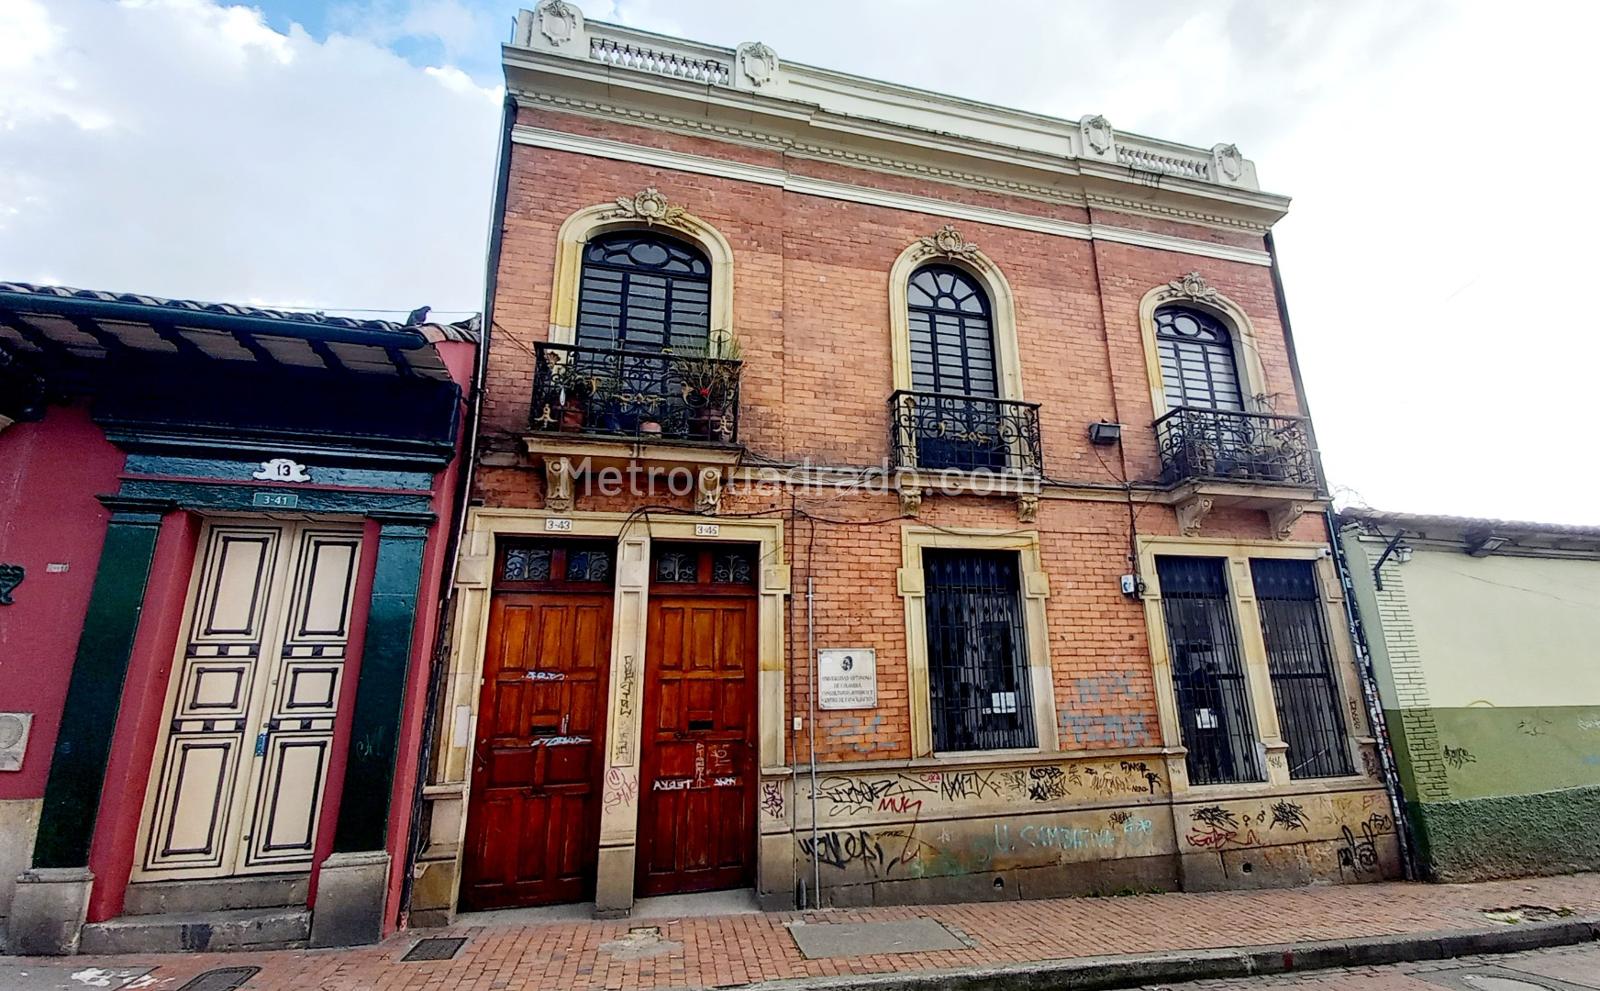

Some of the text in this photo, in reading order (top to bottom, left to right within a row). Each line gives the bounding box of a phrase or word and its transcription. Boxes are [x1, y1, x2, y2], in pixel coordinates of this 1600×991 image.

[277, 463, 291, 477] 13
[263, 495, 288, 505] 3-41
[547, 520, 570, 530] 3-43
